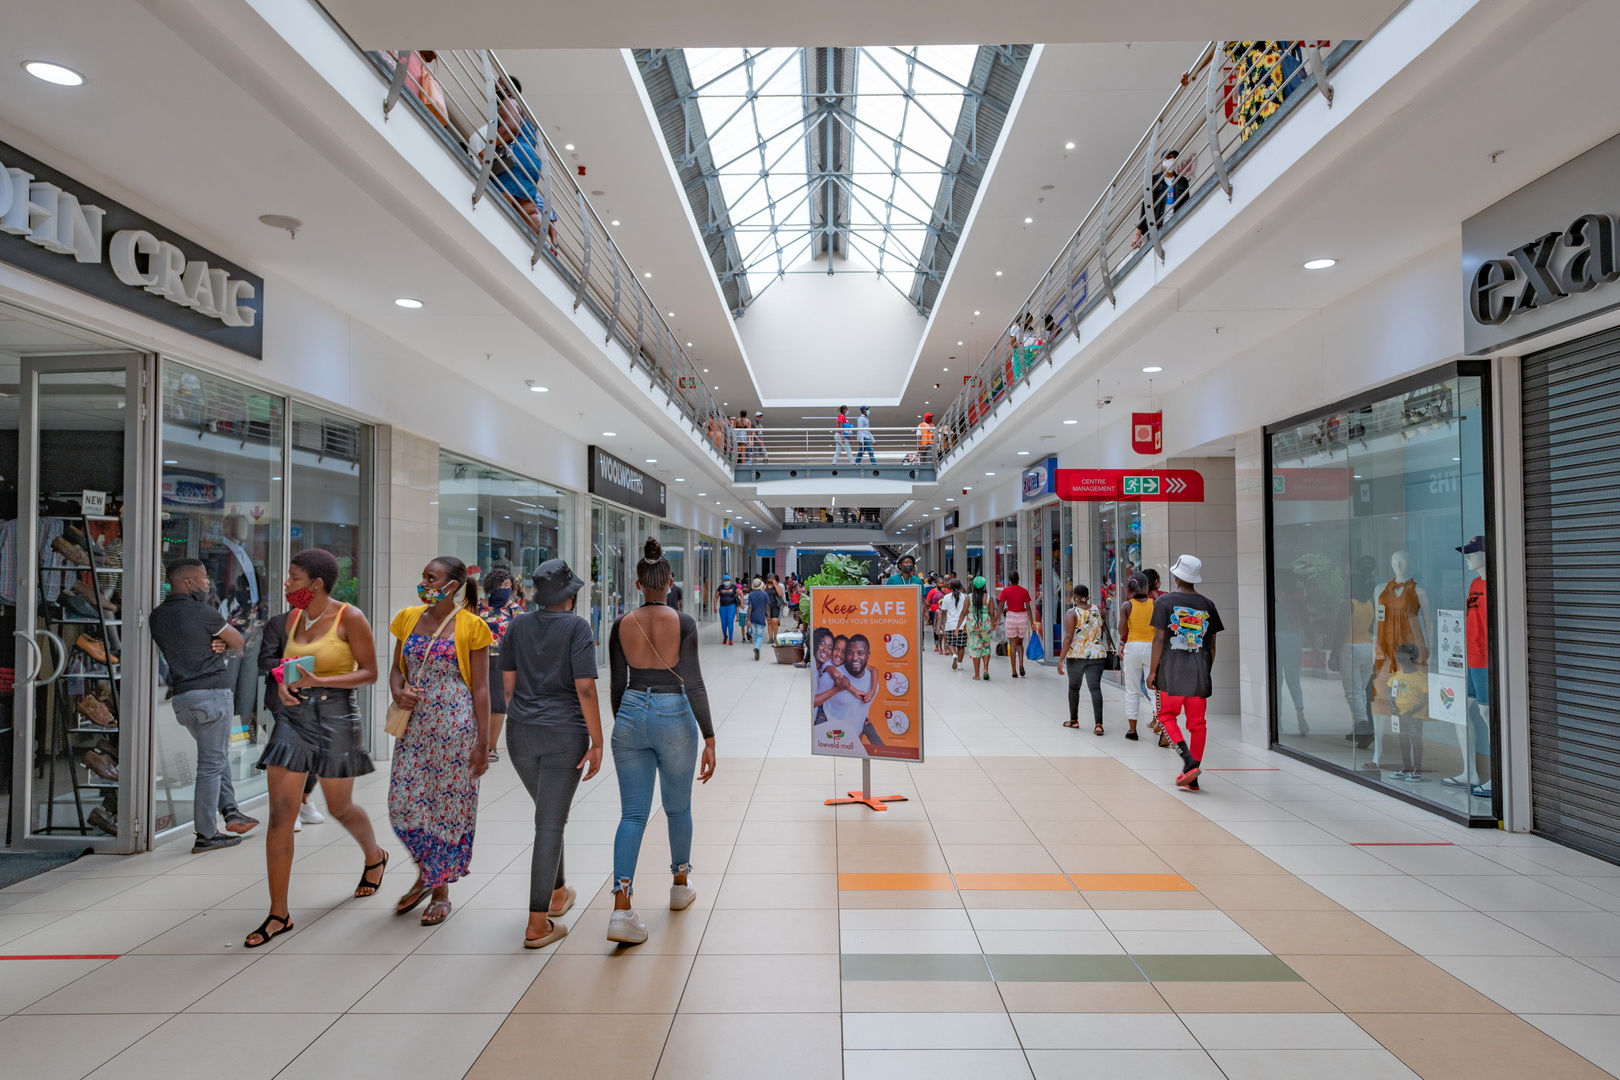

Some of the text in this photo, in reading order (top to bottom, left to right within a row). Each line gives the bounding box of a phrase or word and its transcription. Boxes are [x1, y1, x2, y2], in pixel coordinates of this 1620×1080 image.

[0, 161, 256, 326] HN CRAIG
[1470, 214, 1620, 325] exa
[85, 495, 103, 505] NEW
[822, 595, 905, 620] Keep SAFE
[818, 739, 839, 749] lowveld
